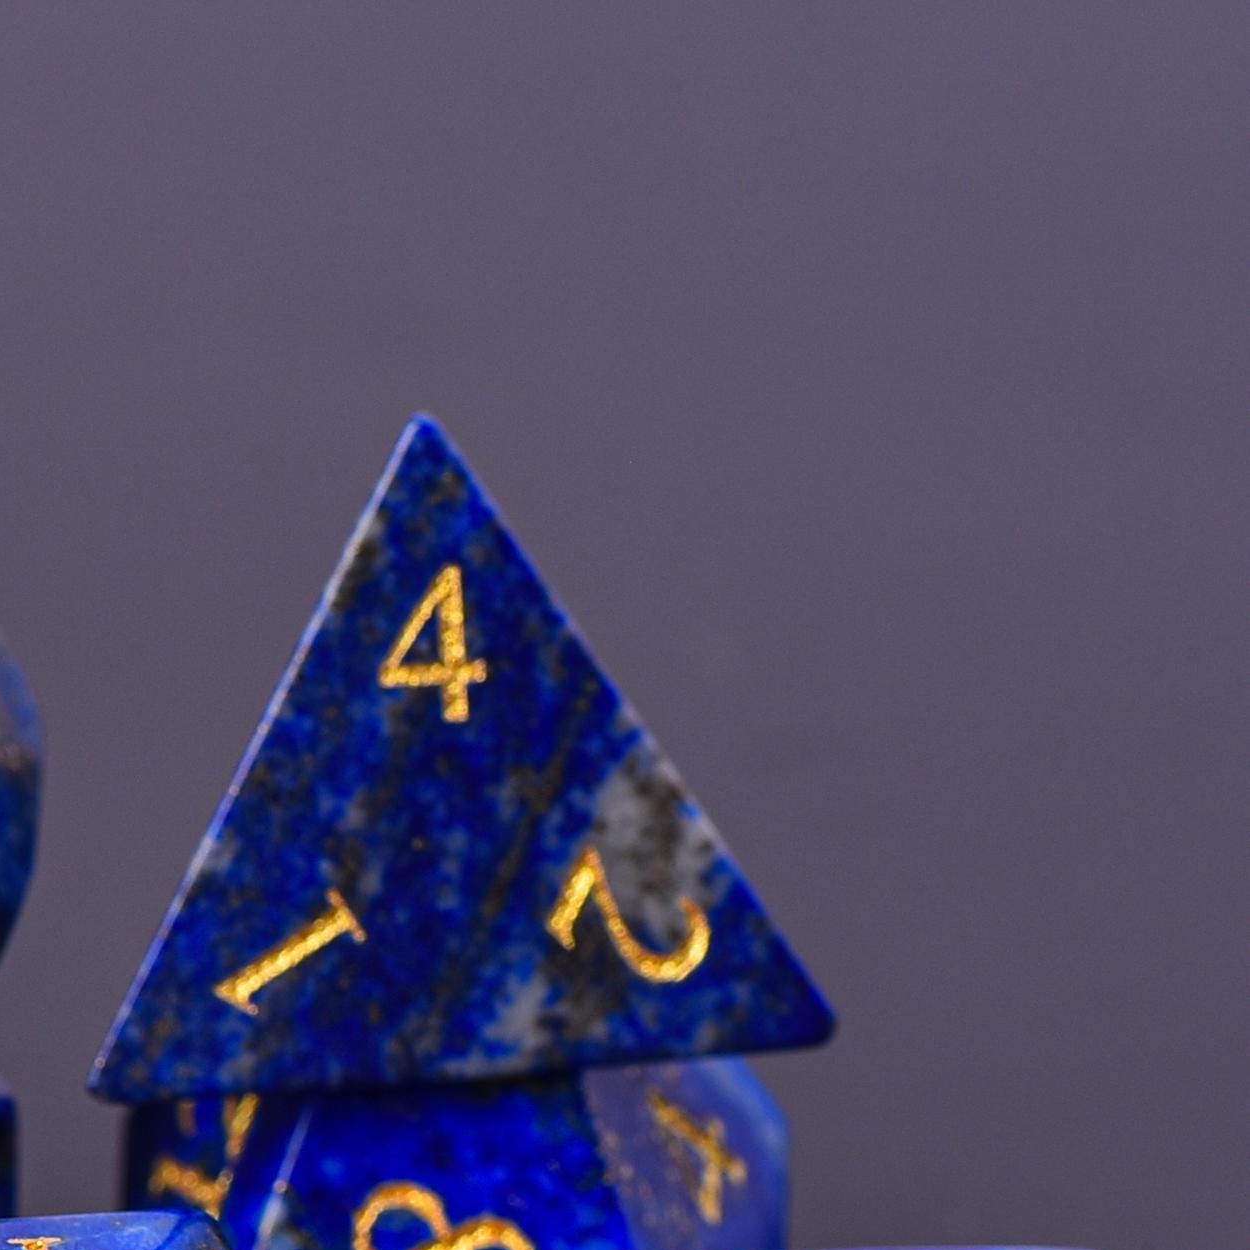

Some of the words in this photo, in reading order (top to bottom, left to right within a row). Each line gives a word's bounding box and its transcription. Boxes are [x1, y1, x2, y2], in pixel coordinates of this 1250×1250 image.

[378, 564, 488, 723] 4
[214, 888, 367, 1015] 1
[549, 845, 712, 983] 2
